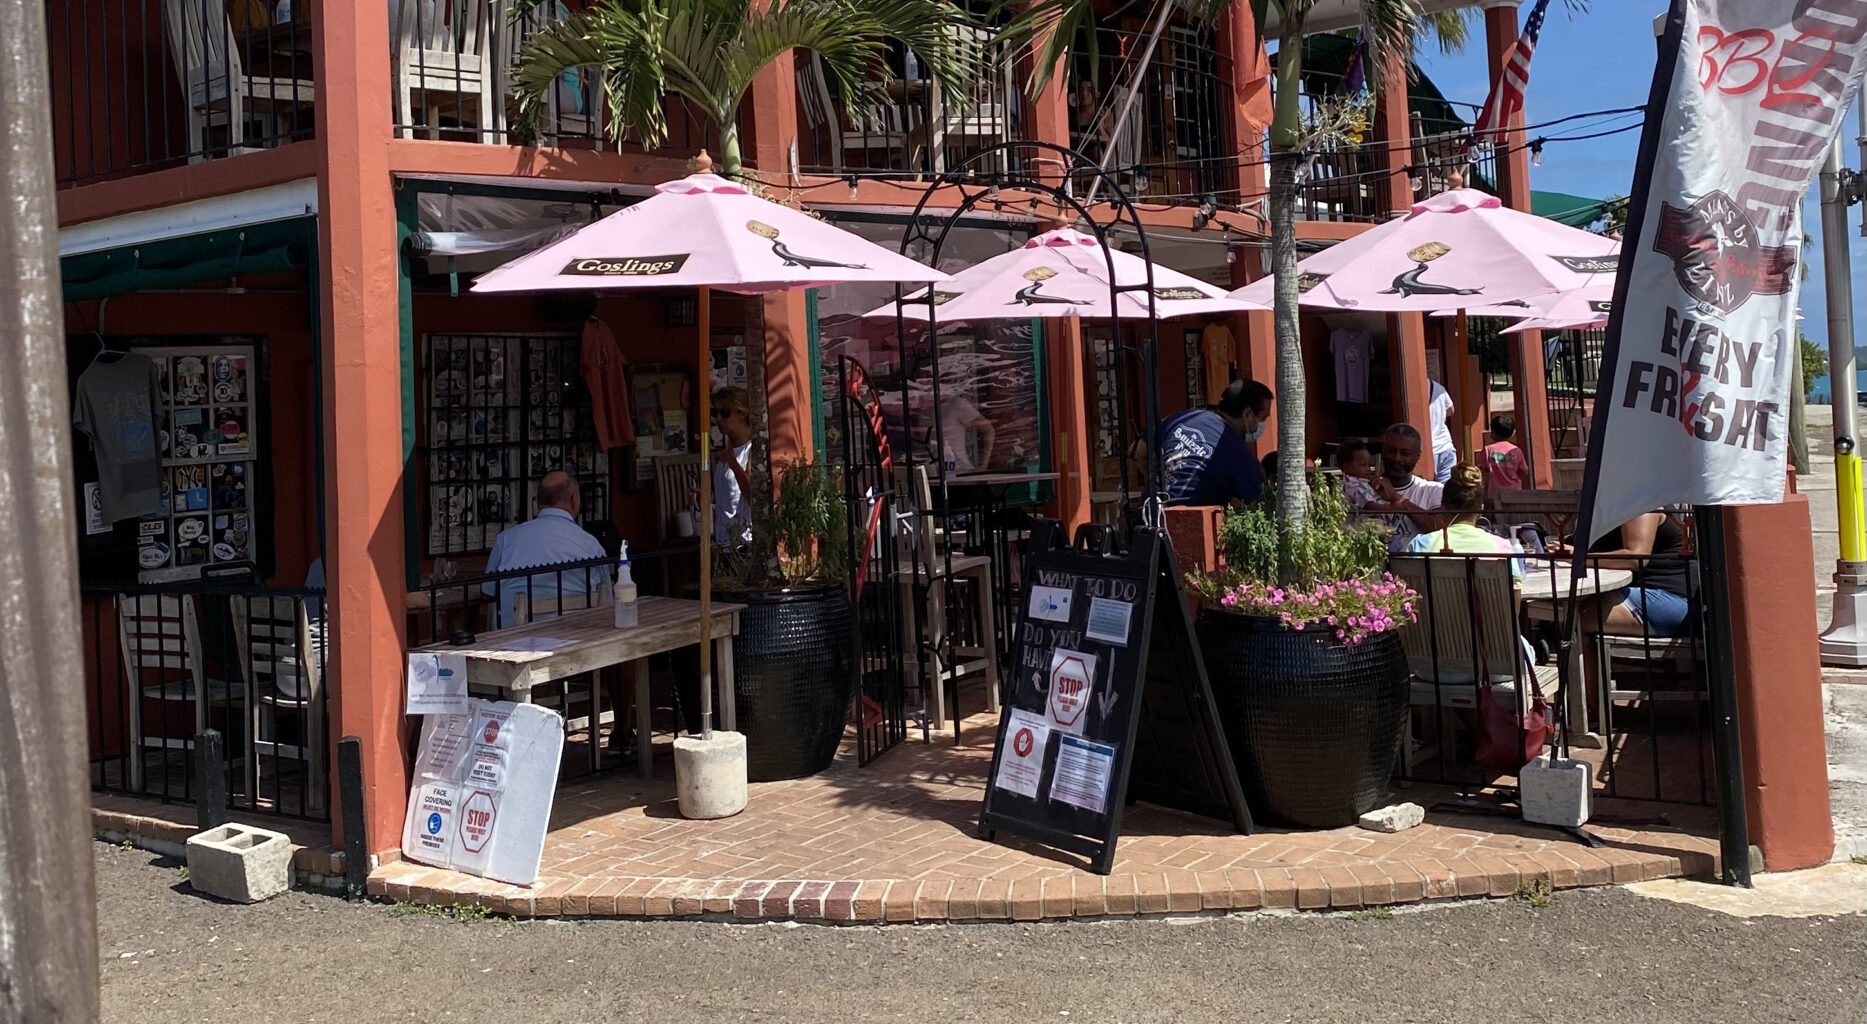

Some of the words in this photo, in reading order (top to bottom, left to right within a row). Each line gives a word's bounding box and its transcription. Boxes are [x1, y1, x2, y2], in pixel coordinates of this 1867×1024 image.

[576, 259, 675, 275] Goslings
[1661, 306, 1763, 388] EVERY
[1694, 391, 1779, 452] SAT
[1038, 569, 1078, 589] WHAT
[1085, 578, 1104, 598] TO
[1110, 579, 1137, 601] DO
[1023, 622, 1044, 645] DO
[1058, 676, 1083, 697] STOP
[425, 796, 452, 807] COVERING
[433, 788, 447, 797] FACE
[467, 809, 490, 828] STOP
